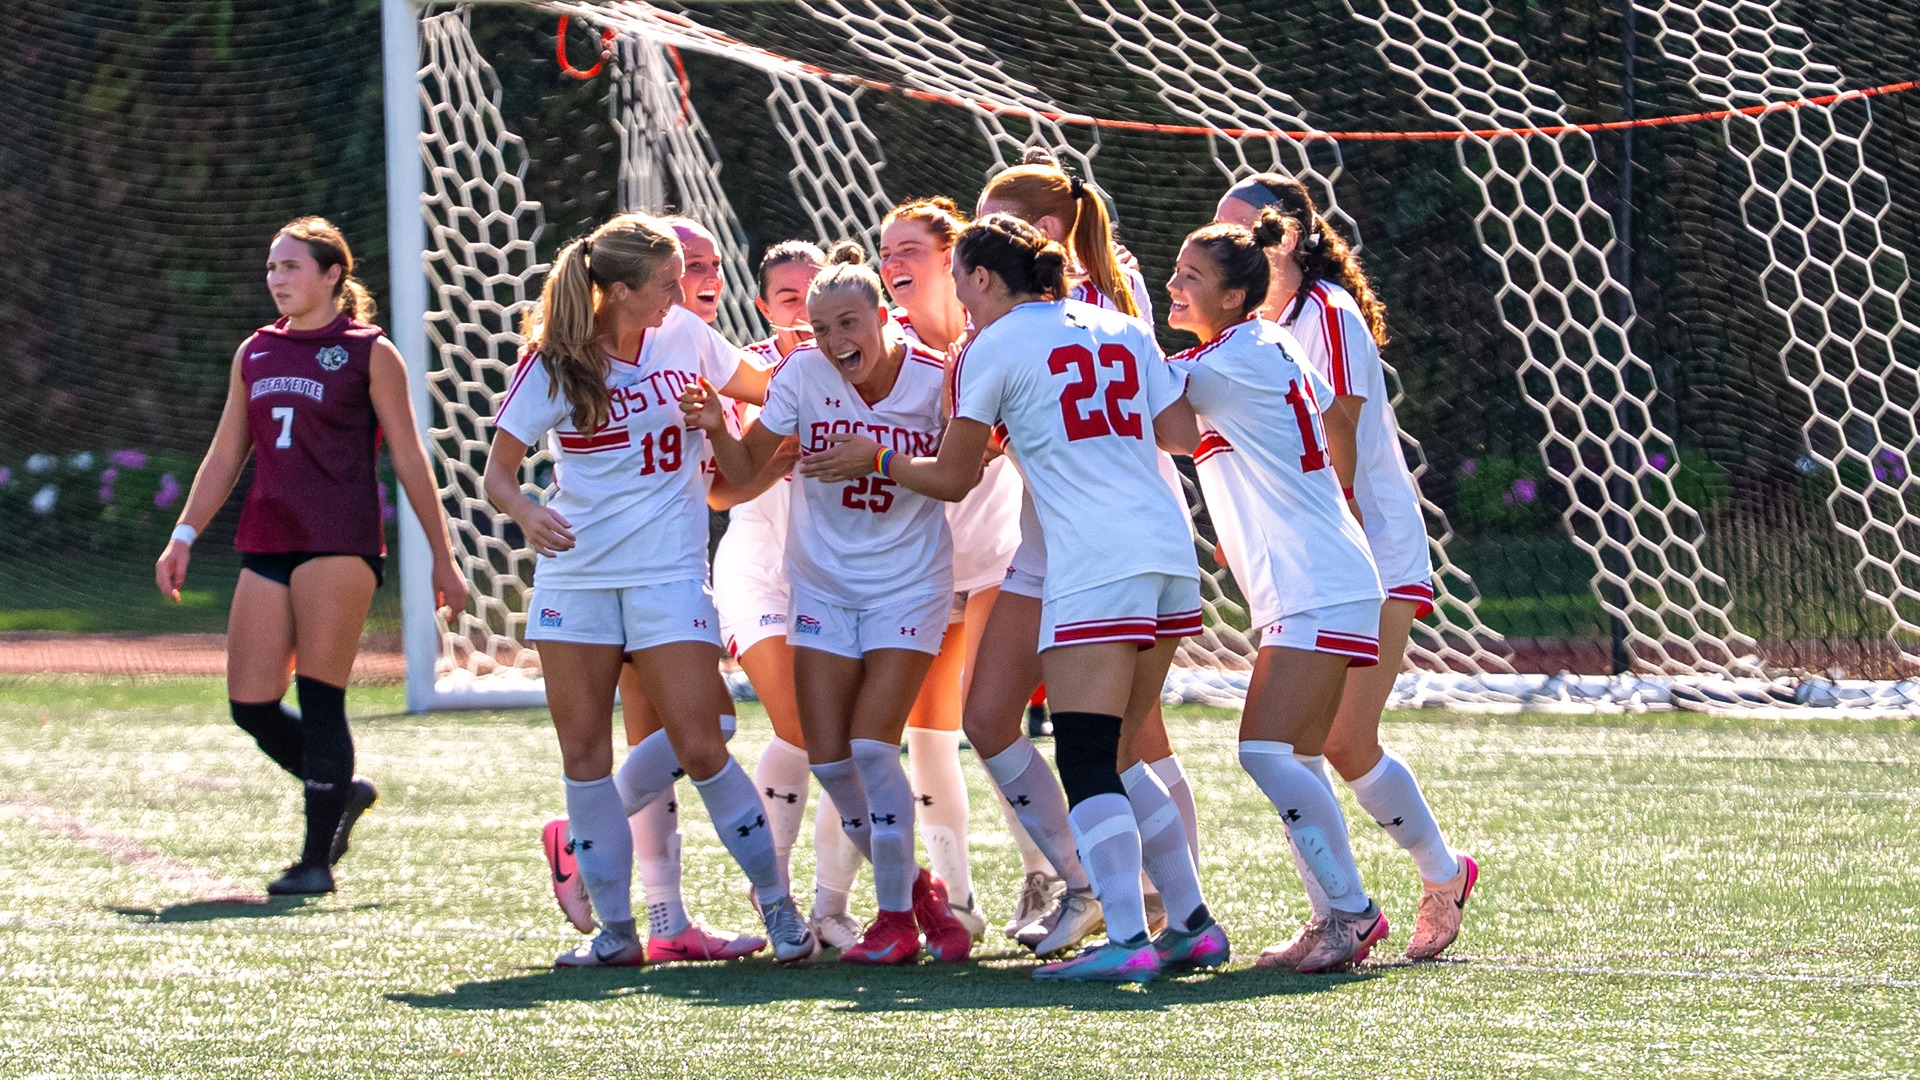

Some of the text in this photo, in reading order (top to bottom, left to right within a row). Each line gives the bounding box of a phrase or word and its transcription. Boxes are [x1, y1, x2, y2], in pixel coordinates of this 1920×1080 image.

[252, 377, 323, 401] LAFAYETTE
[593, 370, 697, 434] OSTO
[1047, 343, 1143, 442] 22
[271, 407, 294, 449] 7
[640, 424, 682, 476] 19
[842, 475, 896, 513] 25
